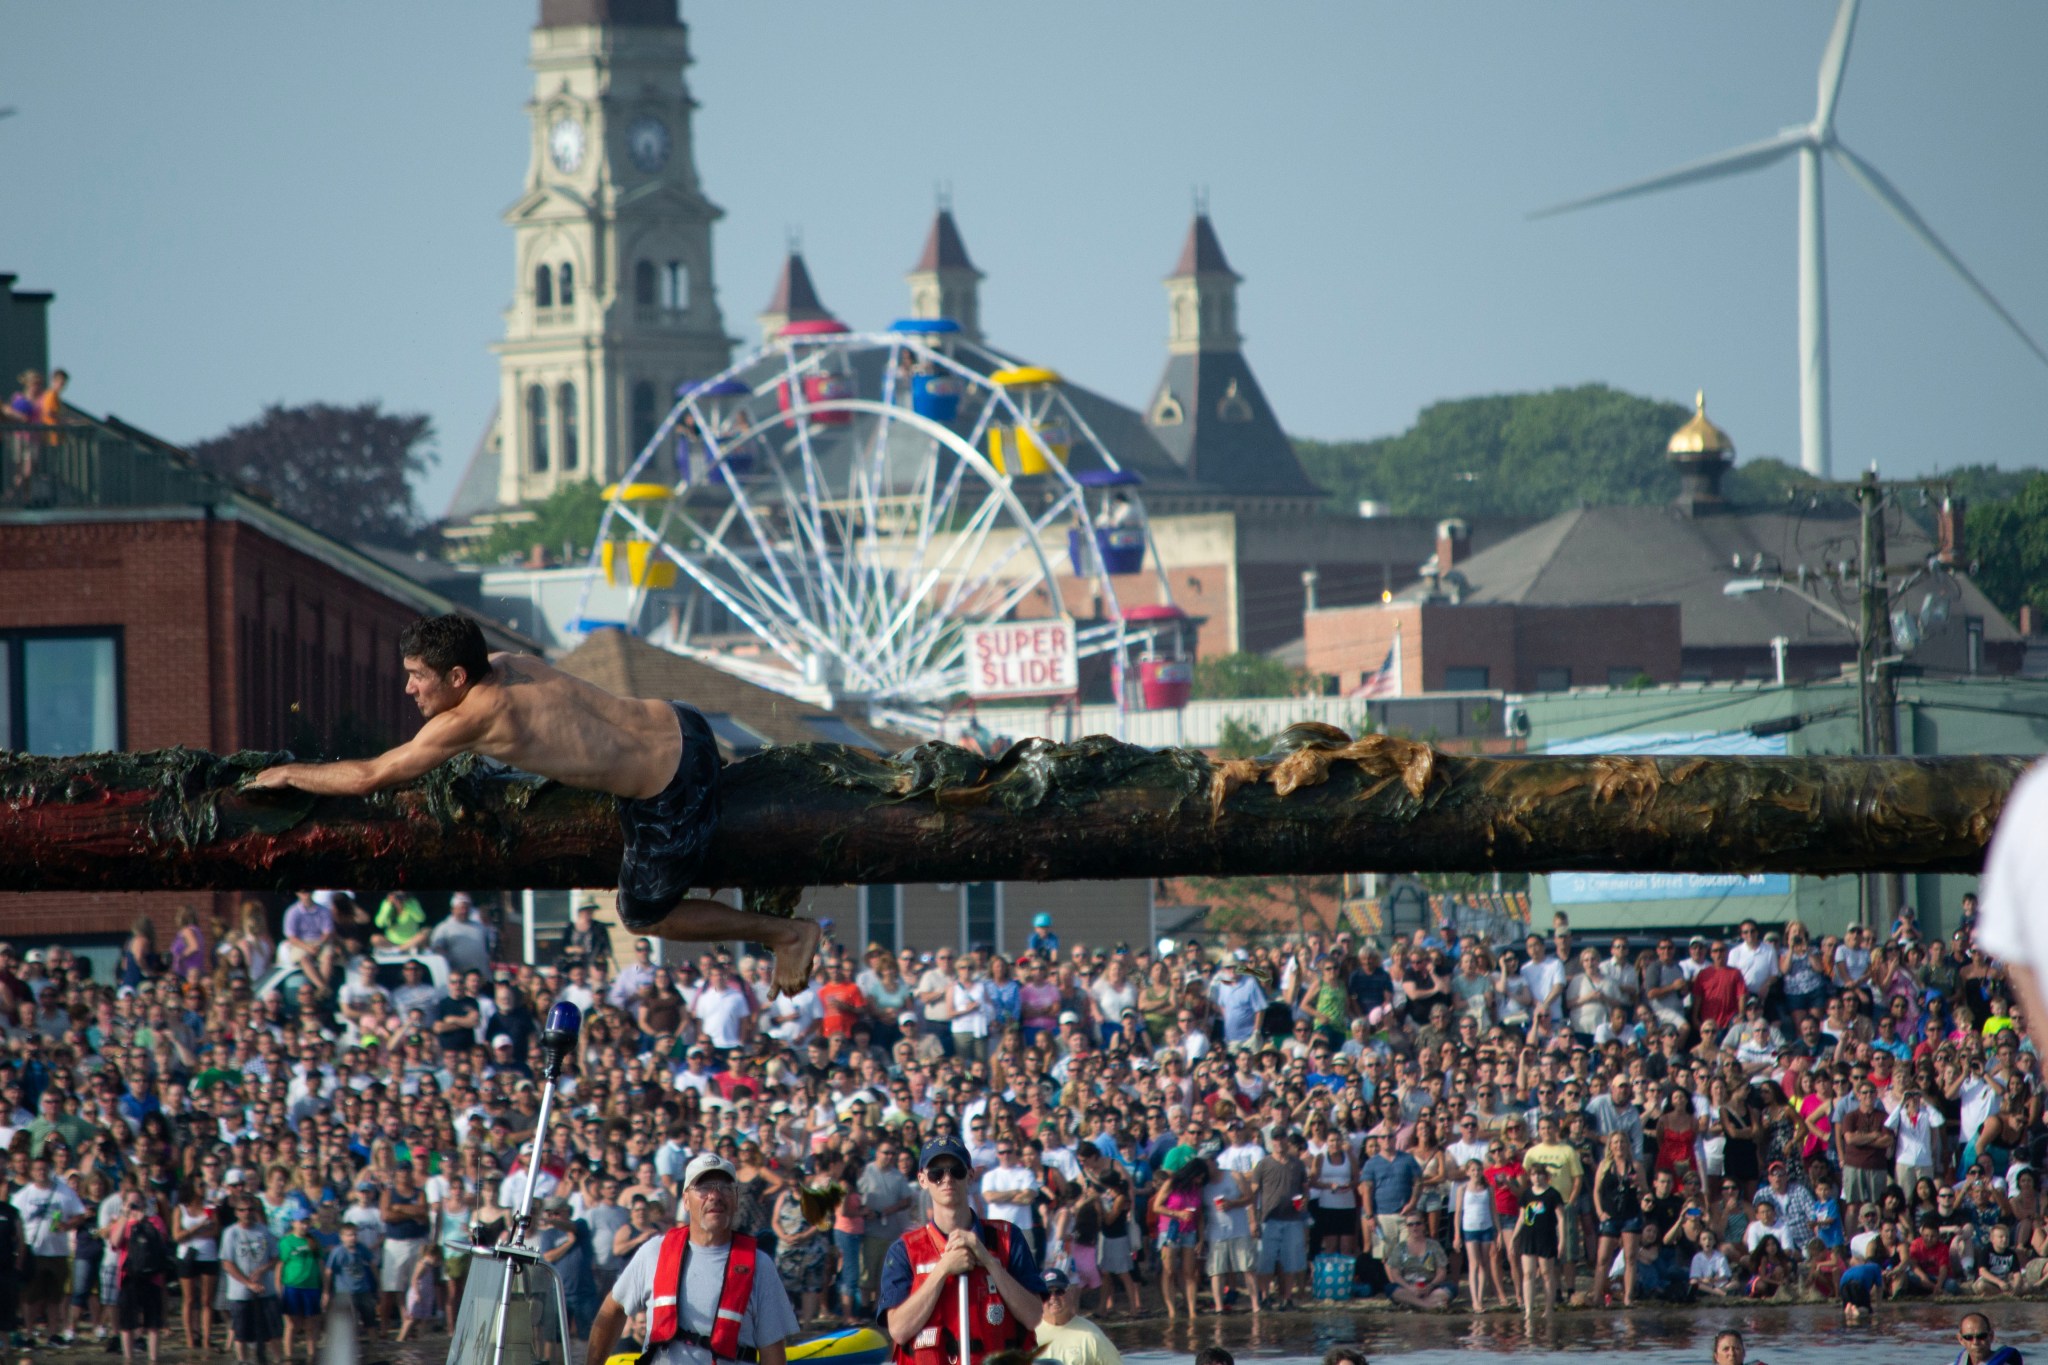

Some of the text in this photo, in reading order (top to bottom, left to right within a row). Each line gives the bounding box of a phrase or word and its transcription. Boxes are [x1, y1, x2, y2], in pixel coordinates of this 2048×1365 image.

[976, 628, 1066, 658] SUPER
[983, 659, 1063, 685] SLIDE
[1650, 874, 1683, 889] Street
[1748, 873, 1766, 886] MA
